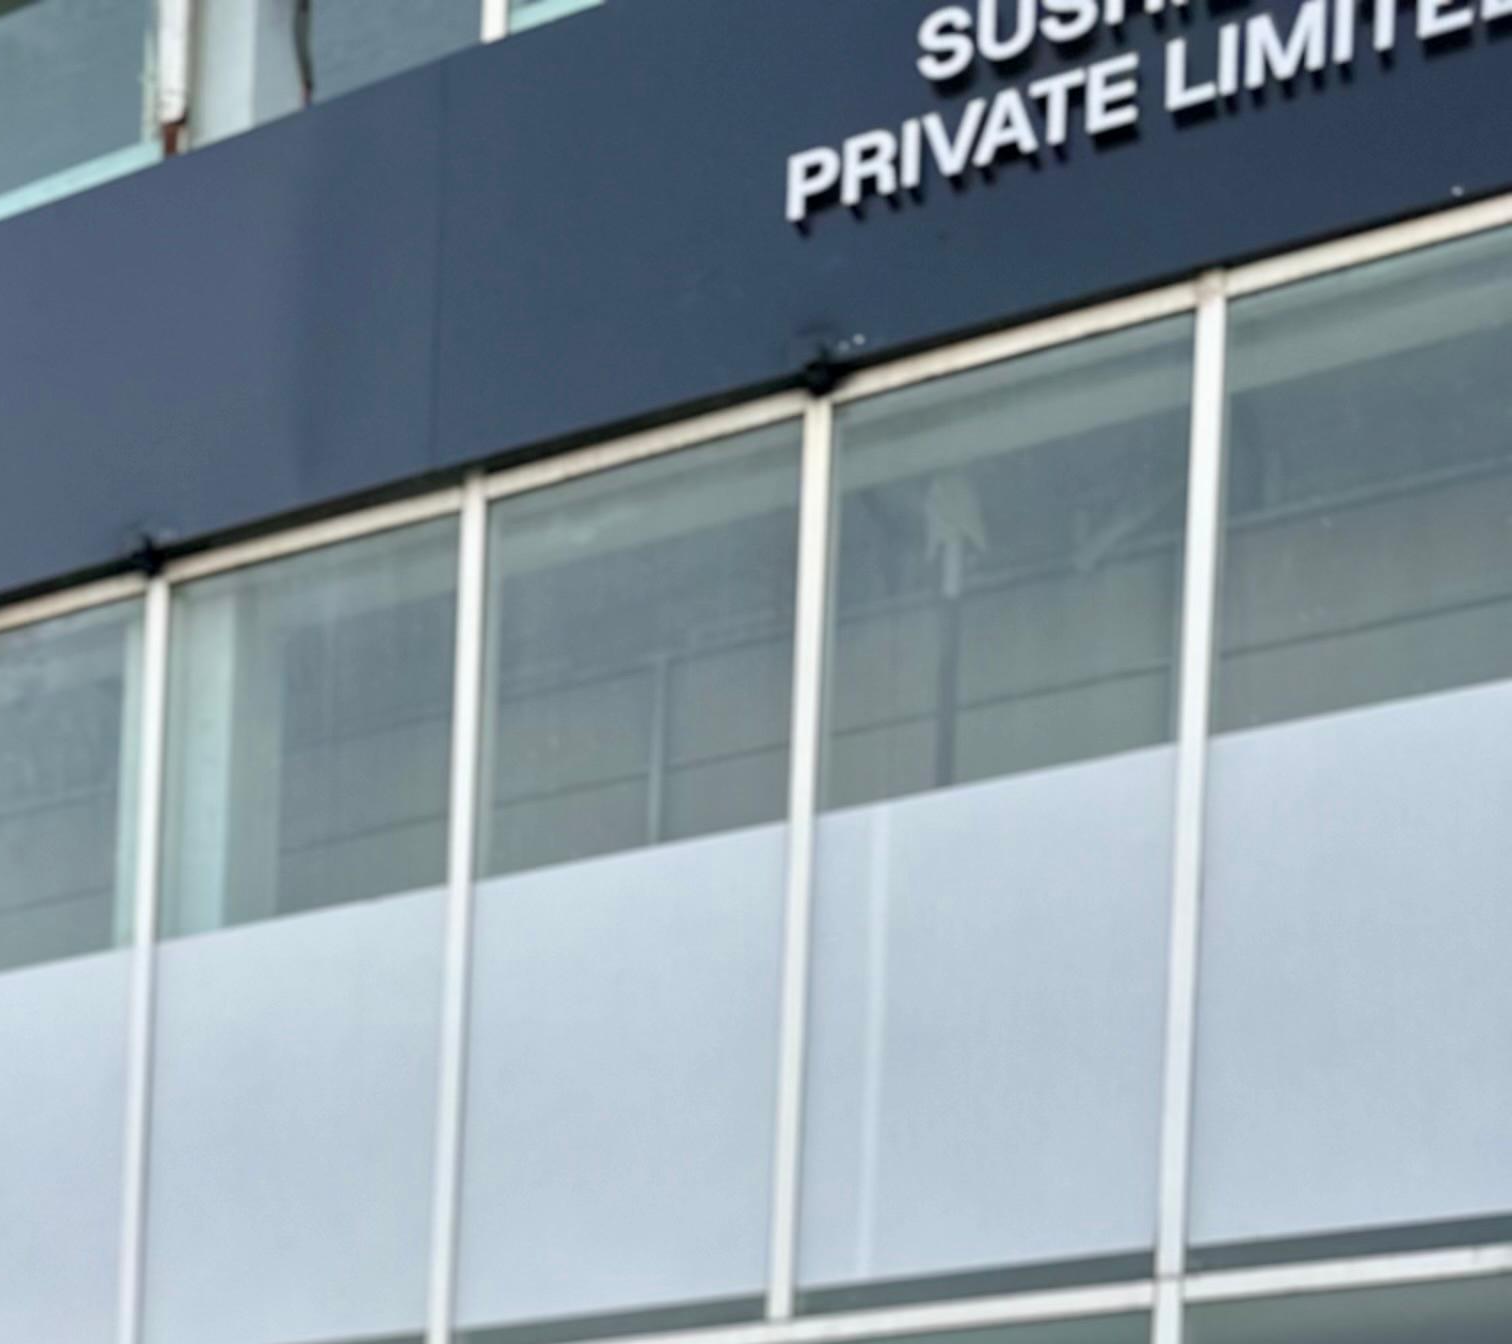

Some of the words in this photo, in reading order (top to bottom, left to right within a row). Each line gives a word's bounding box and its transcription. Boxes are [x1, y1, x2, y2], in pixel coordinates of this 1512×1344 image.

[785, 53, 1139, 223] PRIVATE
[1163, 0, 1512, 111] LIMITE
[916, 0, 1186, 81] SUS
